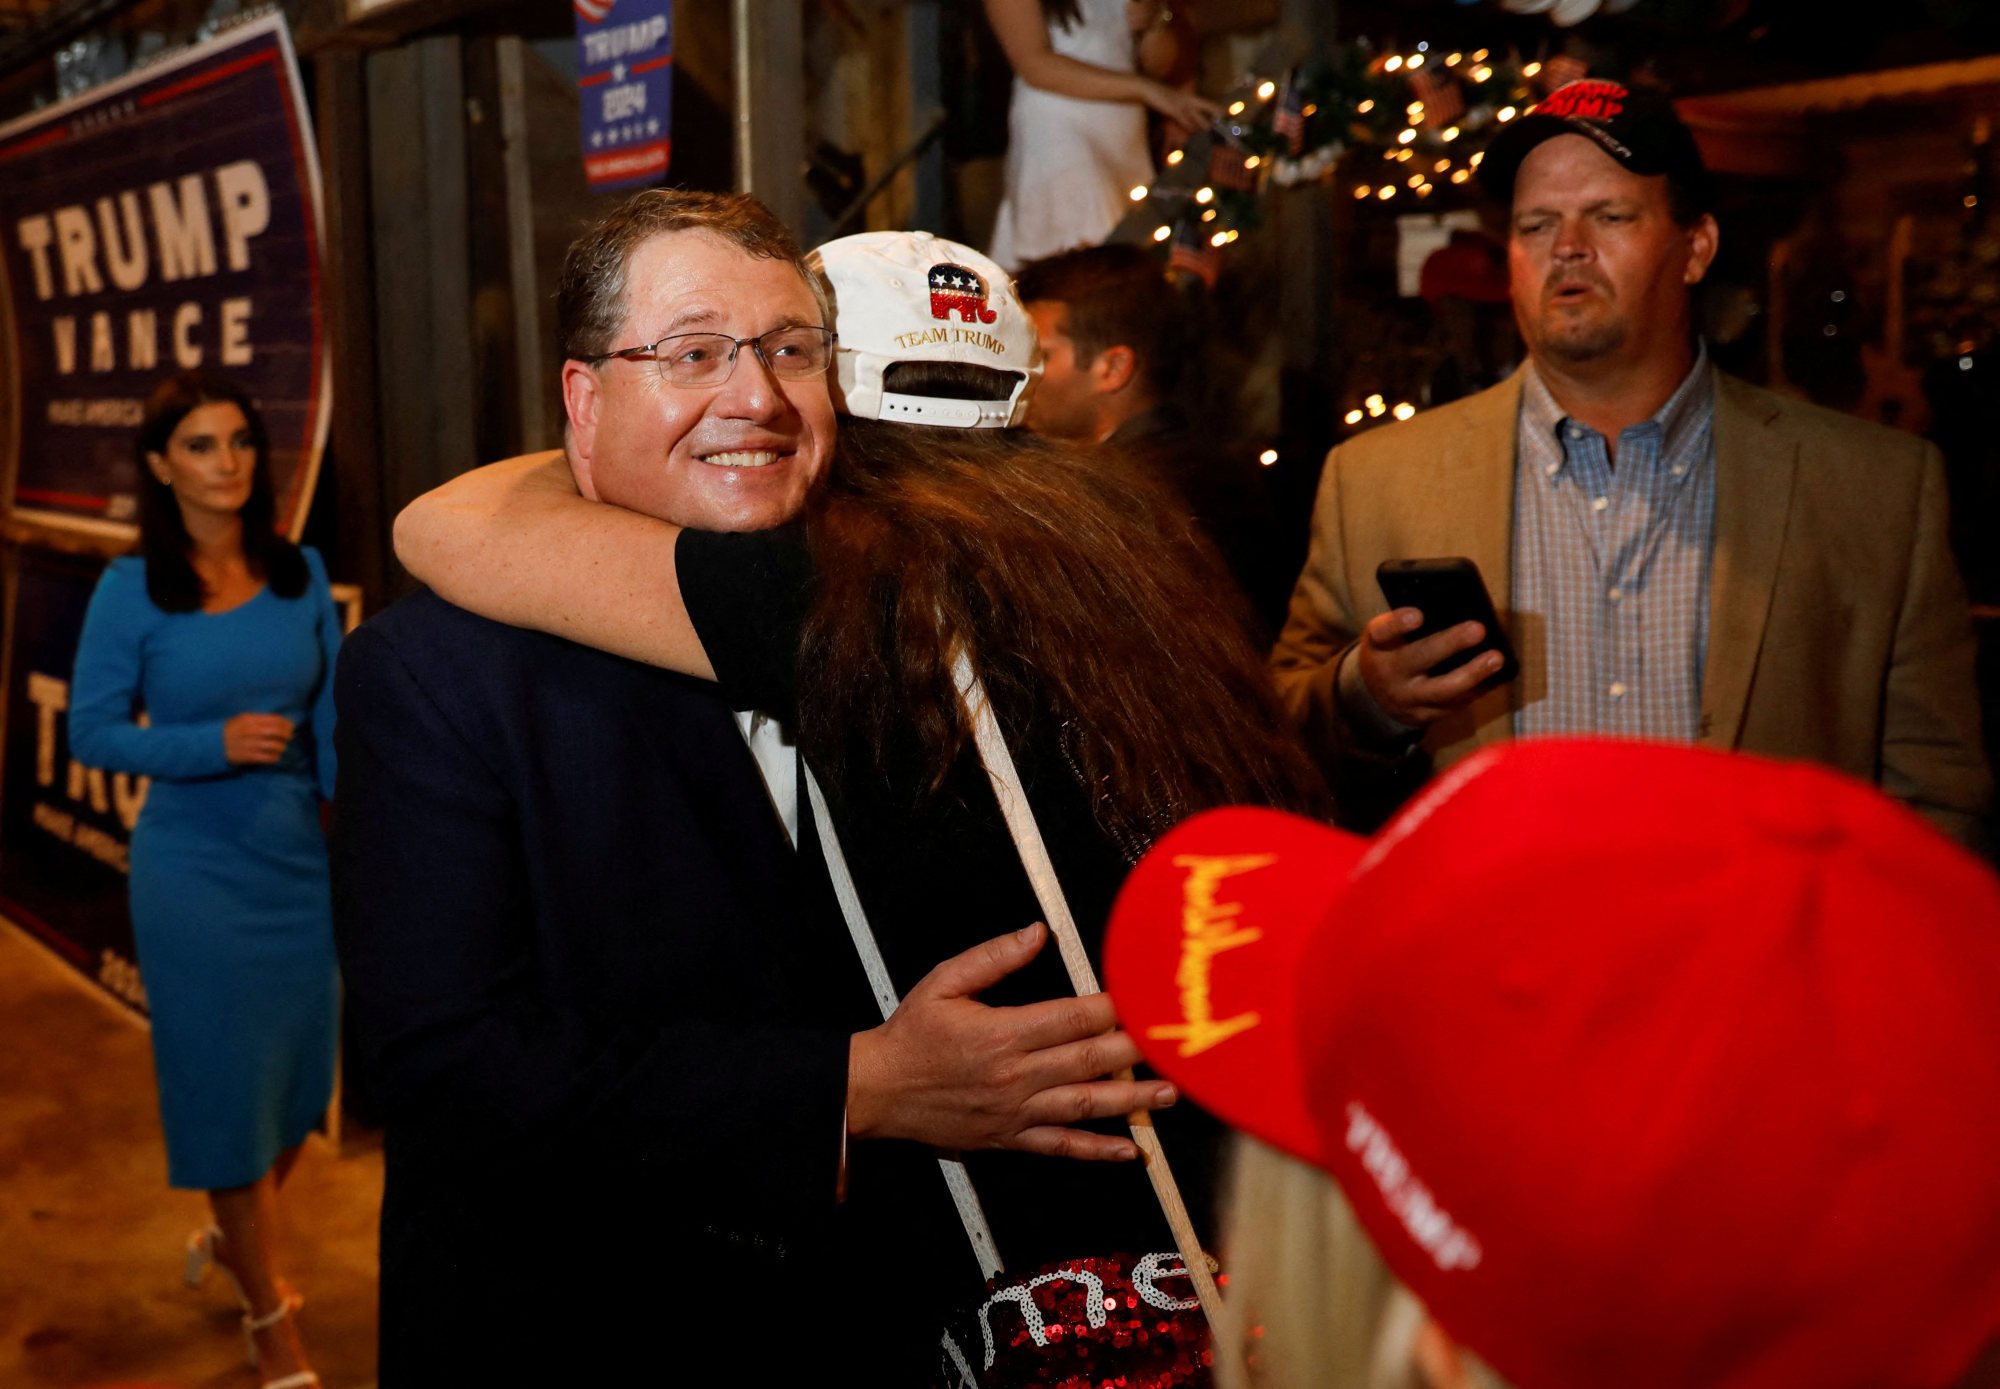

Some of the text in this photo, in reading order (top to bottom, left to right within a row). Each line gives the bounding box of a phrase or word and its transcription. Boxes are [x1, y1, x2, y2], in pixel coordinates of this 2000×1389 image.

[583, 15, 667, 66] TRUMP
[18, 160, 270, 300] TRUMP
[53, 297, 254, 375] VANCE
[894, 326, 1006, 356] TEAM TRUMP
